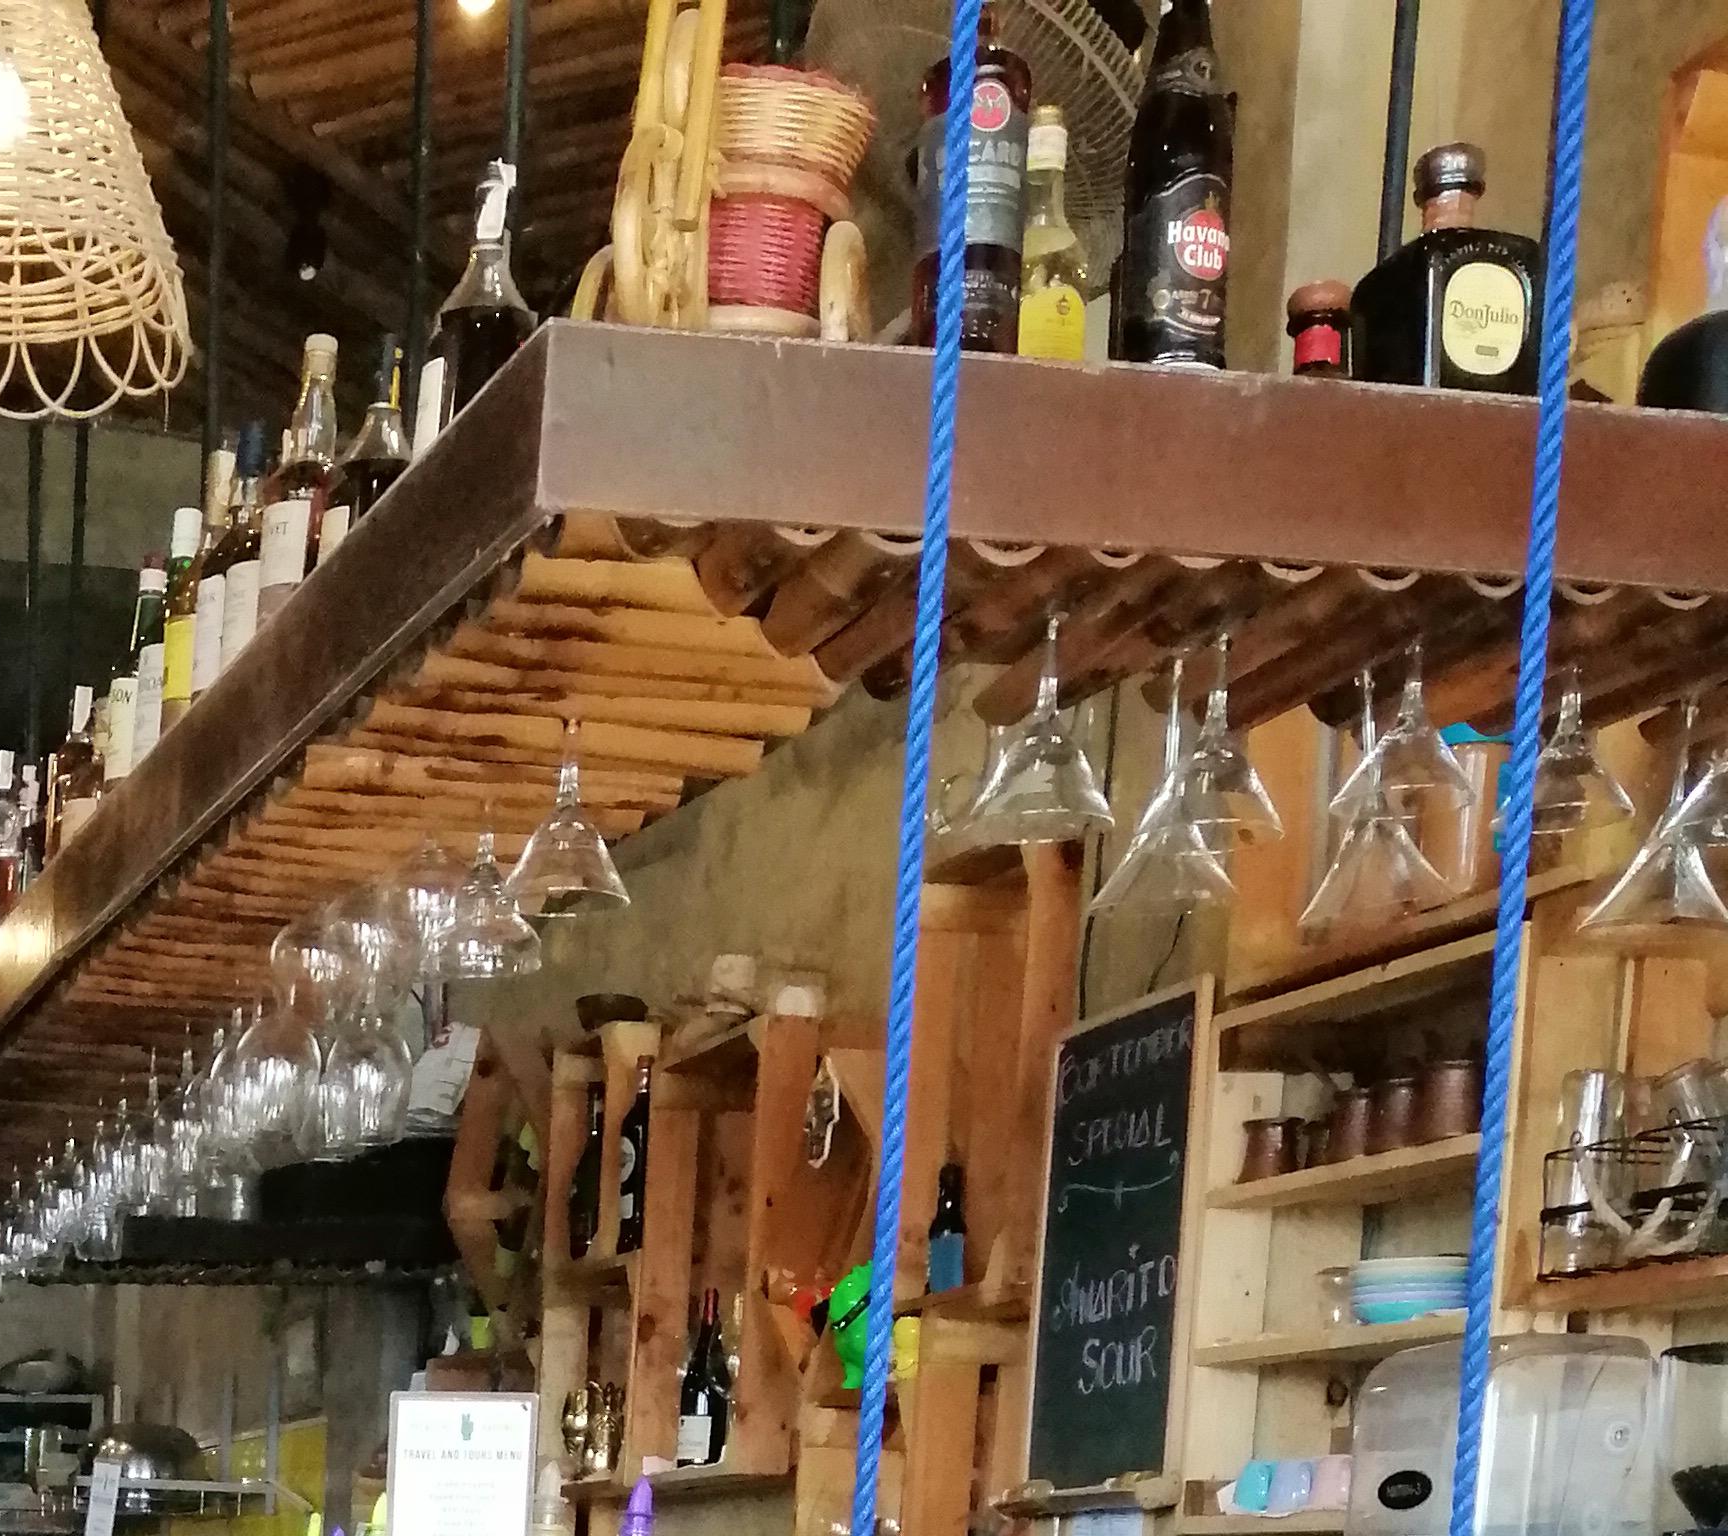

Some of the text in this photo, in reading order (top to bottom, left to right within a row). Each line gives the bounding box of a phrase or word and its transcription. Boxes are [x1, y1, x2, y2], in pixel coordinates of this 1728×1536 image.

[1183, 244, 1223, 270] Club
[1078, 1325, 1158, 1394] SOUR
[404, 1449, 437, 1460] TRAVEL
[440, 1449, 459, 1460] AND
[496, 1450, 523, 1461] MENU
